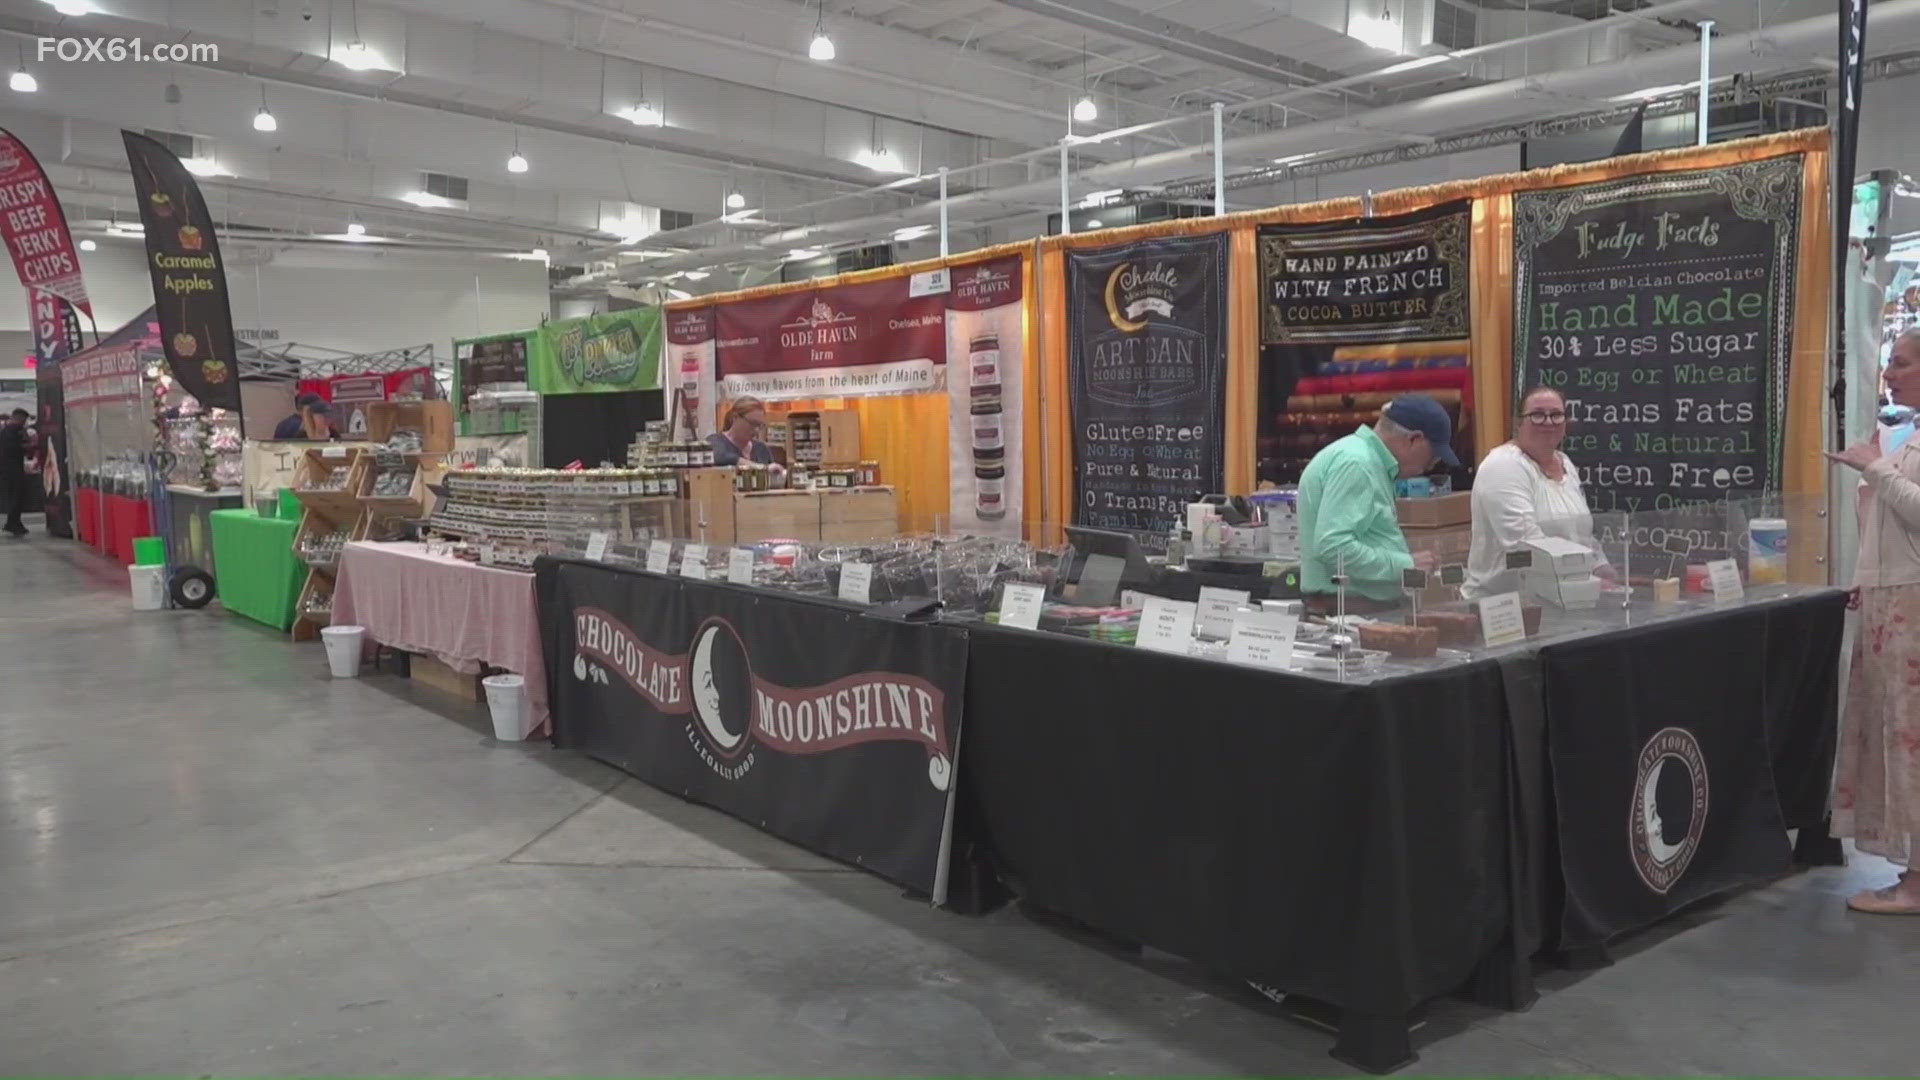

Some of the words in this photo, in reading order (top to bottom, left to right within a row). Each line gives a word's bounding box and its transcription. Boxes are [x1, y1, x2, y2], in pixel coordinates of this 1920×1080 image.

[0, 178, 47, 210] RISPY
[7, 204, 47, 233] BEEF
[14, 227, 62, 259] JERKY
[1574, 219, 1645, 260] Fudge
[1653, 210, 1720, 251] Facts
[24, 252, 73, 281] CHIPS
[155, 252, 216, 269] Caramel
[1285, 257, 1337, 273] HAND
[1342, 245, 1428, 272] PAINTED
[164, 273, 214, 295] Apples
[1274, 279, 1332, 299] WITH
[1342, 267, 1444, 297] FRENCH
[1539, 281, 1605, 298] Imported
[1676, 266, 1765, 285] Chocolate
[1287, 306, 1342, 322] COCOA
[1351, 298, 1427, 318] BUTTER
[1538, 293, 1638, 333] Hand
[1651, 287, 1764, 327] Made
[234, 329, 280, 340] ESTROOMS
[781, 331, 814, 347] OLDE
[817, 325, 857, 344] HAVEN
[1538, 335, 1583, 360] 30%
[1594, 335, 1658, 357] Less
[1669, 331, 1759, 359] Sugar
[810, 349, 834, 361] Farm
[1093, 337, 1194, 369] ARTSAN
[727, 379, 770, 394] Visionary
[805, 375, 825, 388] from
[829, 375, 848, 387] the
[851, 371, 879, 386] heart
[882, 369, 893, 384] of
[895, 367, 928, 383] Maine
[1538, 367, 1569, 387] No
[1577, 368, 1620, 393] Egg
[1631, 369, 1663, 385] or
[1673, 362, 1758, 385] Wheat
[1565, 400, 1660, 422] Trans
[1675, 398, 1754, 423] Fats
[1154, 424, 1204, 441] Free
[1563, 434, 1598, 451] re
[1609, 434, 1622, 451] &
[1635, 431, 1756, 453] Natural
[1087, 444, 1104, 457] No
[1109, 444, 1135, 460] Egg
[1086, 461, 1124, 476] Pure
[1129, 464, 1139, 476] &
[1577, 462, 1654, 487] uten
[1669, 463, 1754, 488] Free
[1157, 495, 1186, 514] Fat
[1590, 488, 1641, 514] ily
[577, 614, 681, 704] CHOCOLATE
[756, 682, 937, 743] MOONSHINE
[685, 722, 733, 780] ILLEGALLY
[734, 753, 756, 780] GOOD
